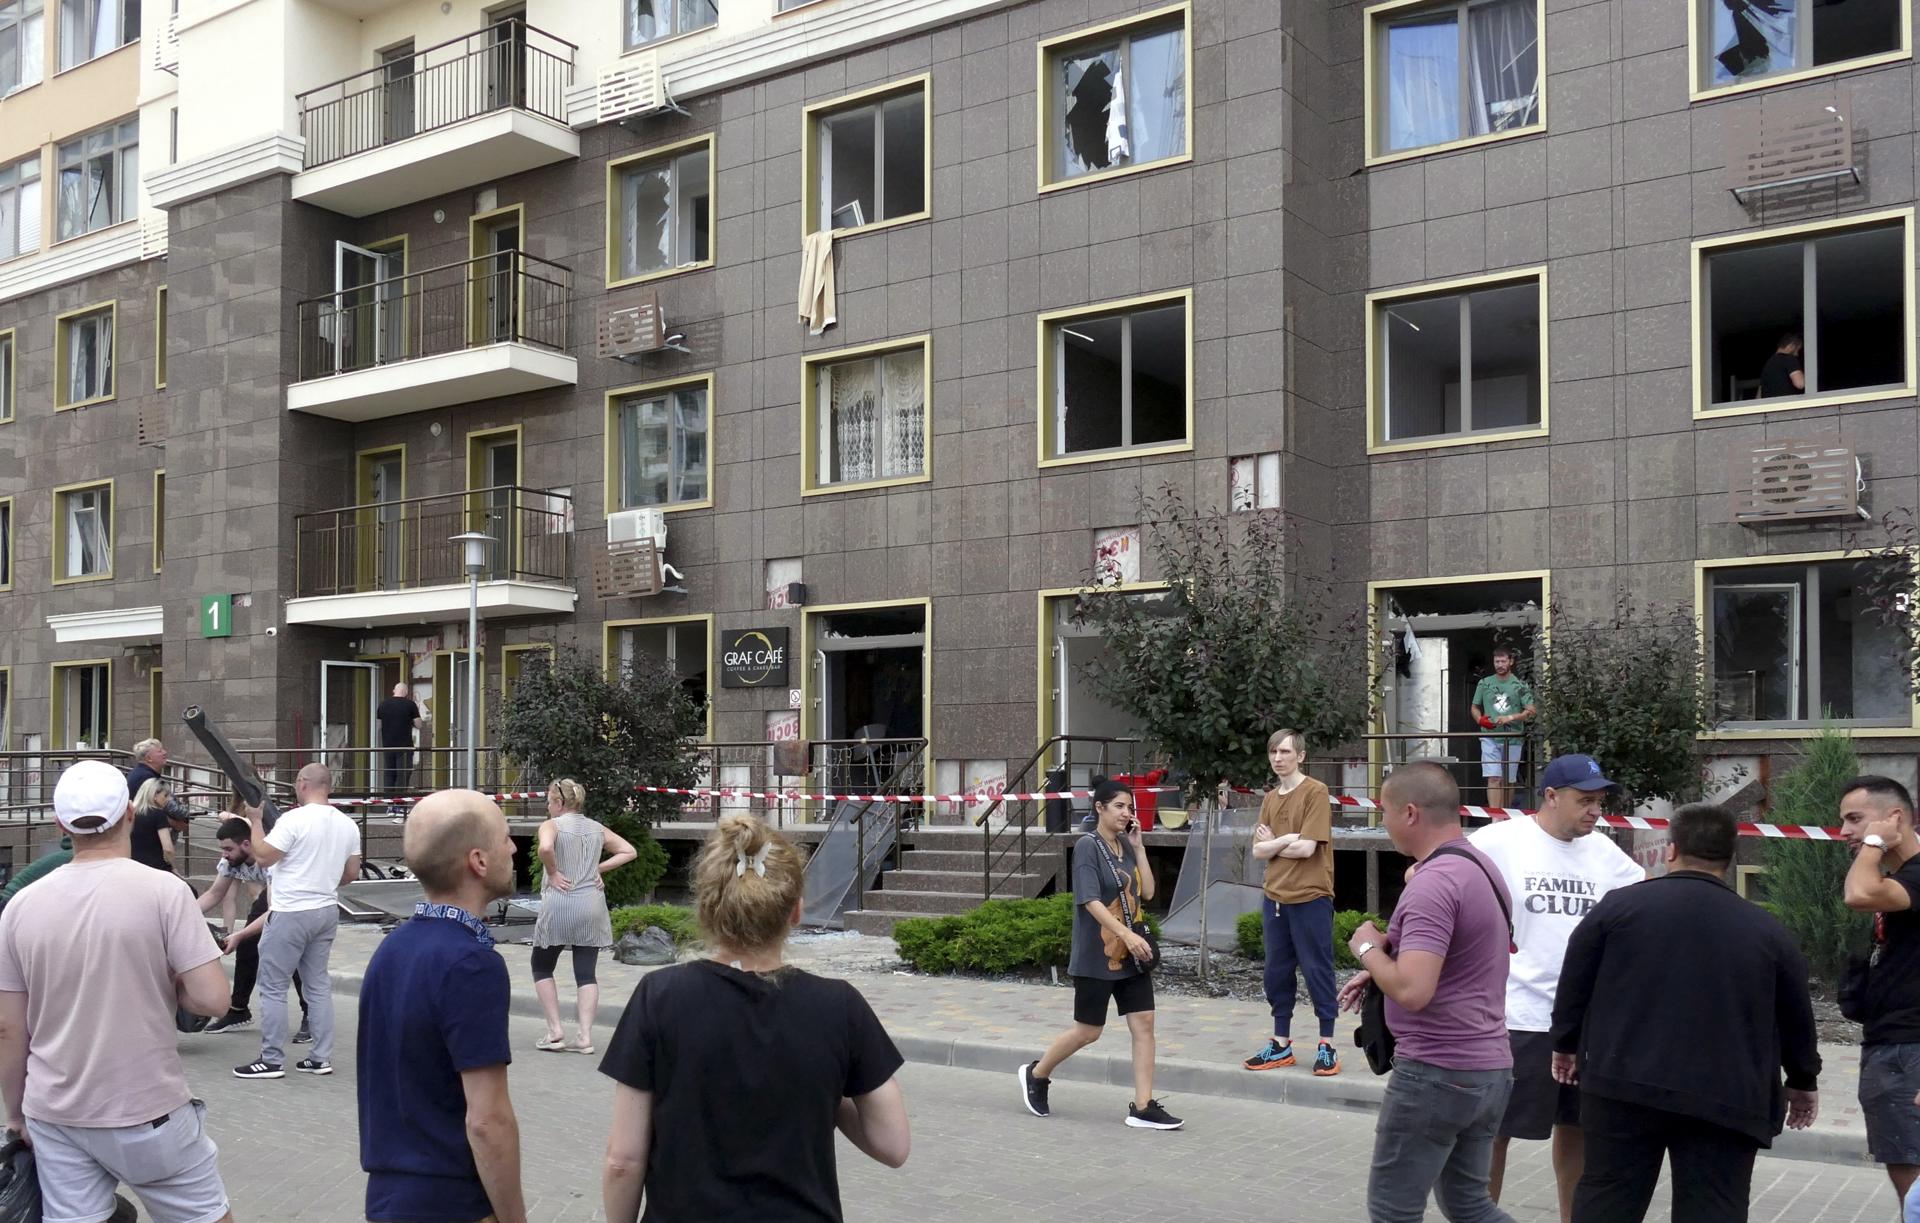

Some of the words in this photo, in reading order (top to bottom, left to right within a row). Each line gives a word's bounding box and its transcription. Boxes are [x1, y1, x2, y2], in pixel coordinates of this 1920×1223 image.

[208, 600, 219, 631] 1
[724, 651, 753, 666] GRAF
[755, 646, 783, 664] CAFÉ
[1524, 877, 1597, 896] FAMILY
